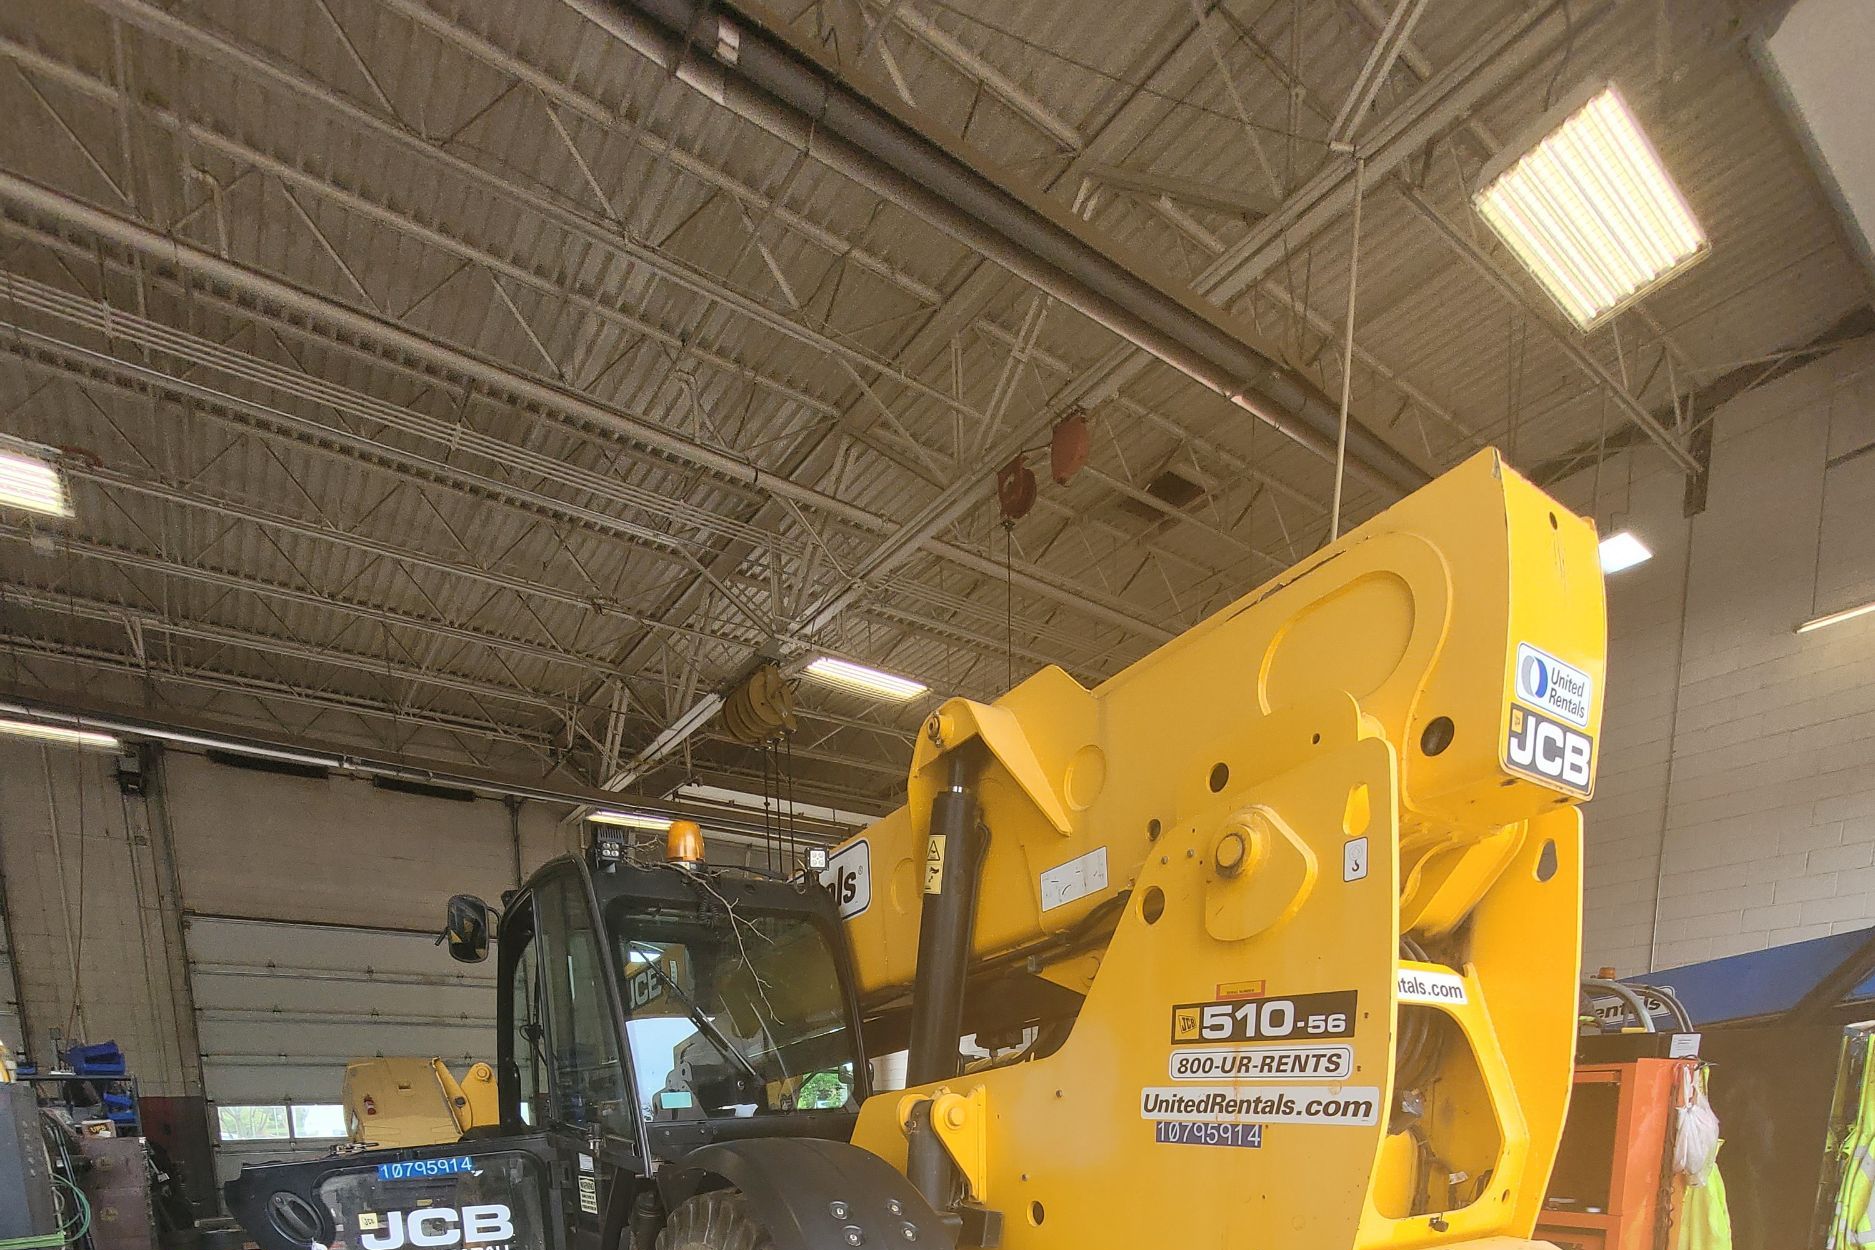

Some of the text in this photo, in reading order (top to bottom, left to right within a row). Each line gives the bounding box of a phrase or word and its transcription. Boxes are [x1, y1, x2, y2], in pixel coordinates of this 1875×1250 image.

[1550, 667, 1584, 698] United
[1549, 687, 1585, 719] Rentals
[1510, 715, 1591, 786] JCB
[1201, 1000, 1346, 1040] 510-56
[1596, 997, 1661, 1019] entls
[1177, 1053, 1342, 1075] 800-UR-RENTS
[1143, 1093, 1373, 1118] UnitedRentals.com
[1157, 1122, 1261, 1147] 10795914
[380, 1156, 473, 1179] 10795914
[361, 1204, 514, 1250] JCB
